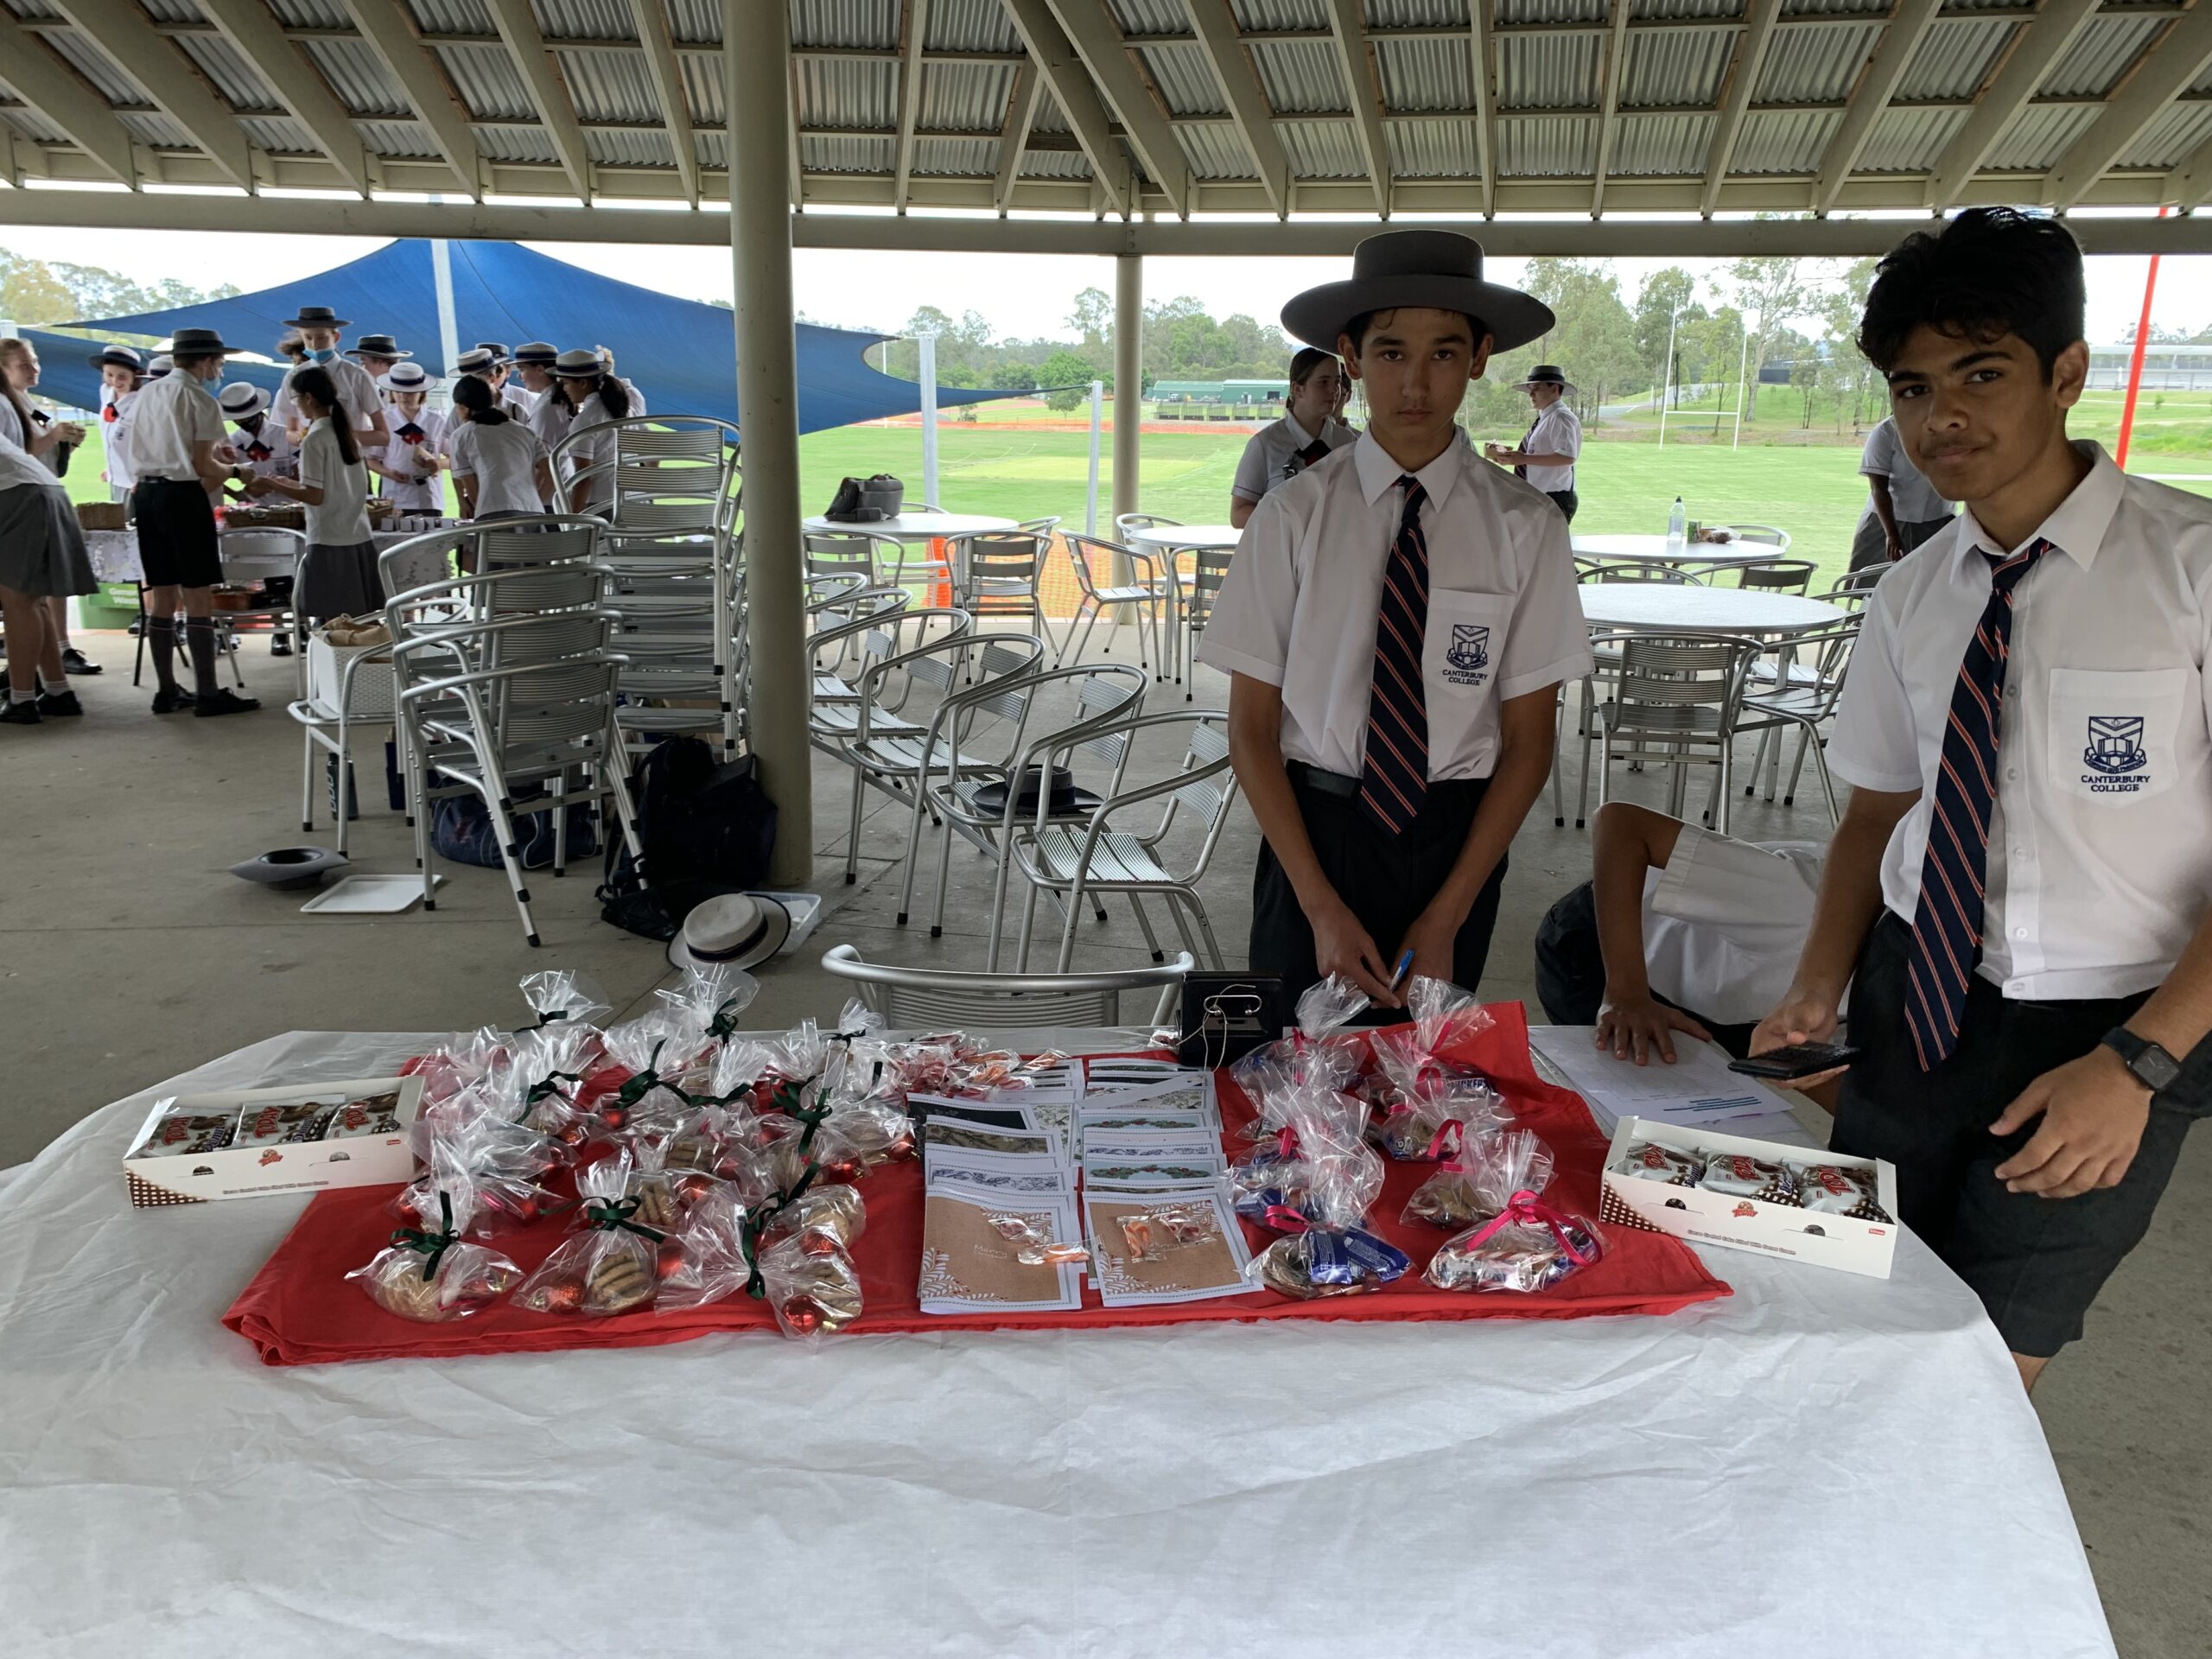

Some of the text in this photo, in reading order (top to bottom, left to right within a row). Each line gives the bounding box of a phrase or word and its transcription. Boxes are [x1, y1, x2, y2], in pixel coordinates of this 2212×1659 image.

[1442, 669, 1488, 680] CANTERBURY
[1448, 677, 1480, 686] COLLEGE
[2081, 775, 2151, 784] CANTERBURY
[2091, 784, 2139, 792] COLLEGE
[254, 1106, 284, 1139] TODAY
